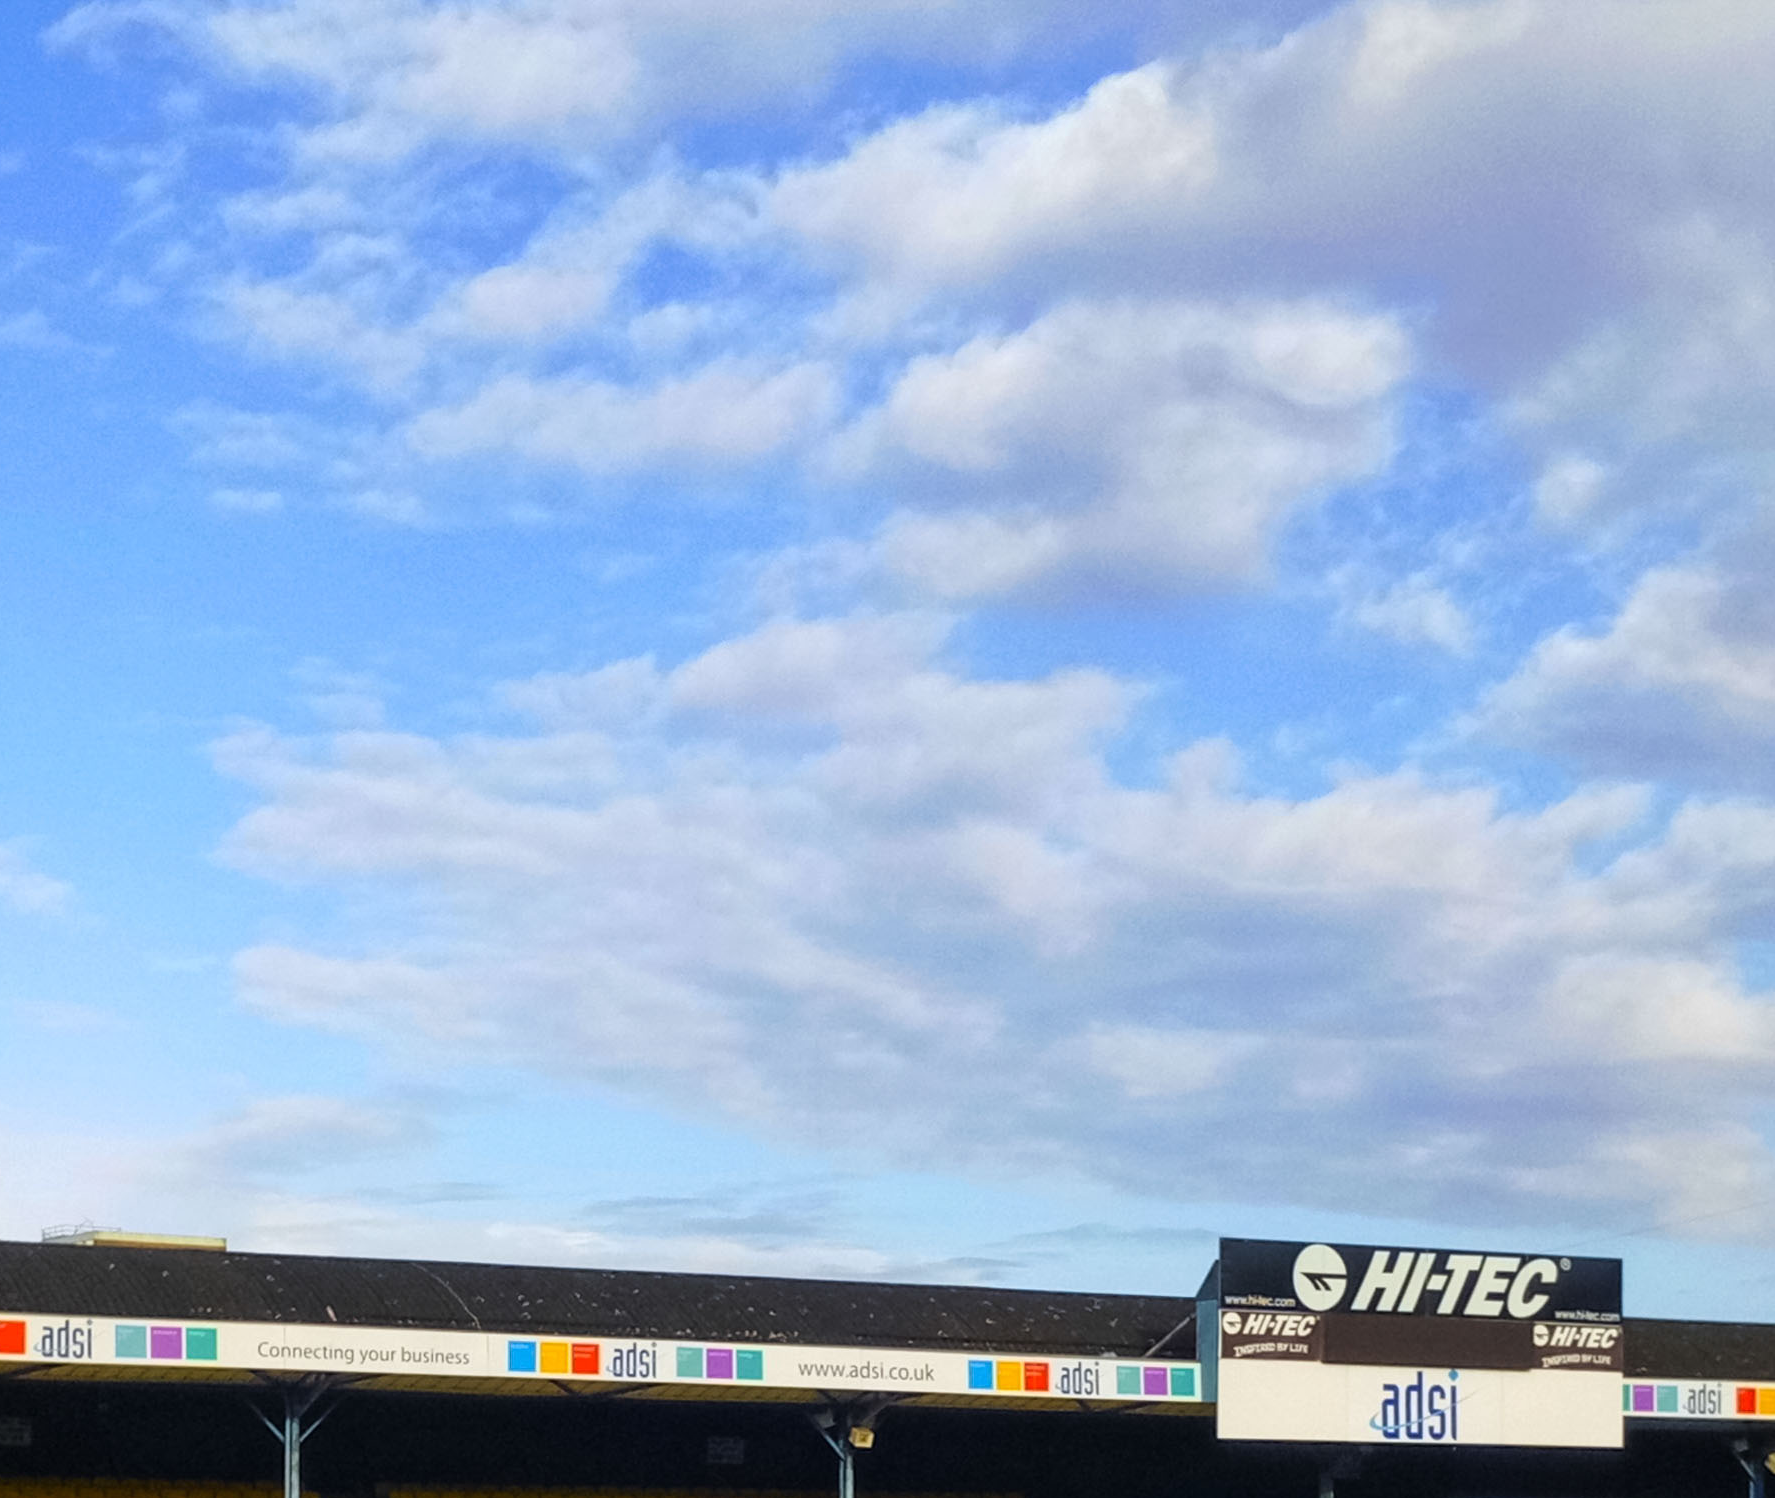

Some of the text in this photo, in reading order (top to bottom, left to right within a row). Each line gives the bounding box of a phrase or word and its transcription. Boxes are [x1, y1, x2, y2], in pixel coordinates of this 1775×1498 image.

[1350, 1250, 1559, 1319] HI-TEC
[41, 1319, 93, 1359] adsi
[1242, 1313, 1317, 1337] HI-TEC
[1549, 1326, 1619, 1349] HI-TEC
[257, 1341, 470, 1365] Connecting your business
[612, 1342, 657, 1378] adsi
[798, 1361, 935, 1381] www.adsi.co.uk
[1061, 1361, 1100, 1395] adsi
[1382, 1368, 1459, 1441] adsi
[1687, 1383, 1722, 1415] adsi
